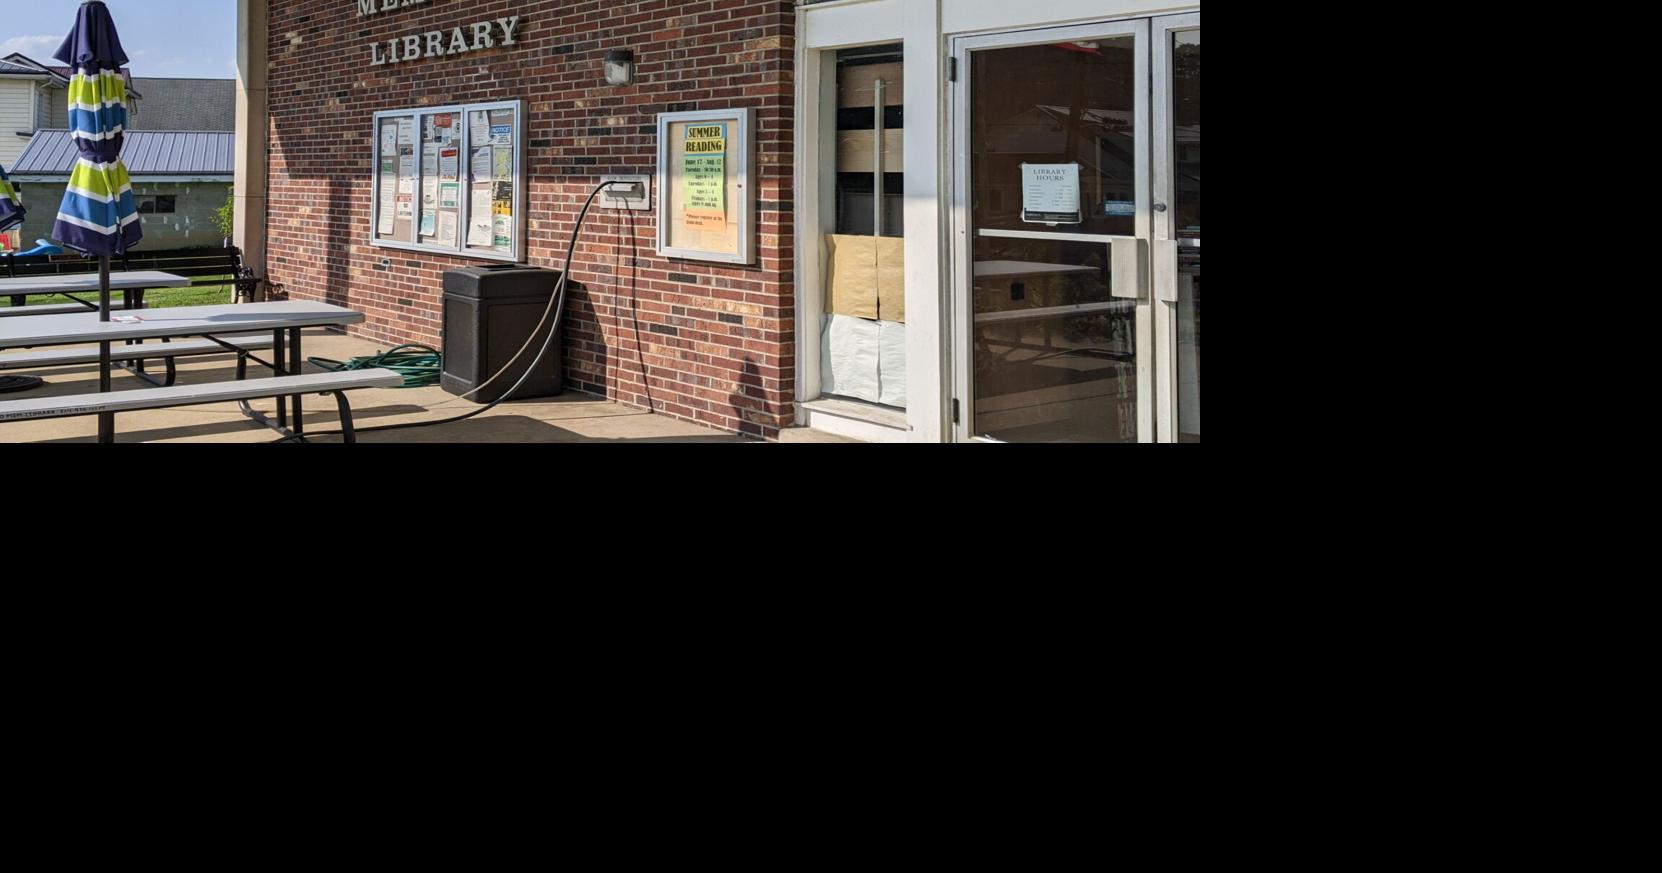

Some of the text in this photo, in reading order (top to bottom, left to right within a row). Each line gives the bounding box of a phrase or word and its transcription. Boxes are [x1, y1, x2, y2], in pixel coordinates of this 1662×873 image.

[369, 16, 519, 66] LIBRARY
[689, 126, 720, 137] SUMMER
[686, 140, 722, 151] READING
